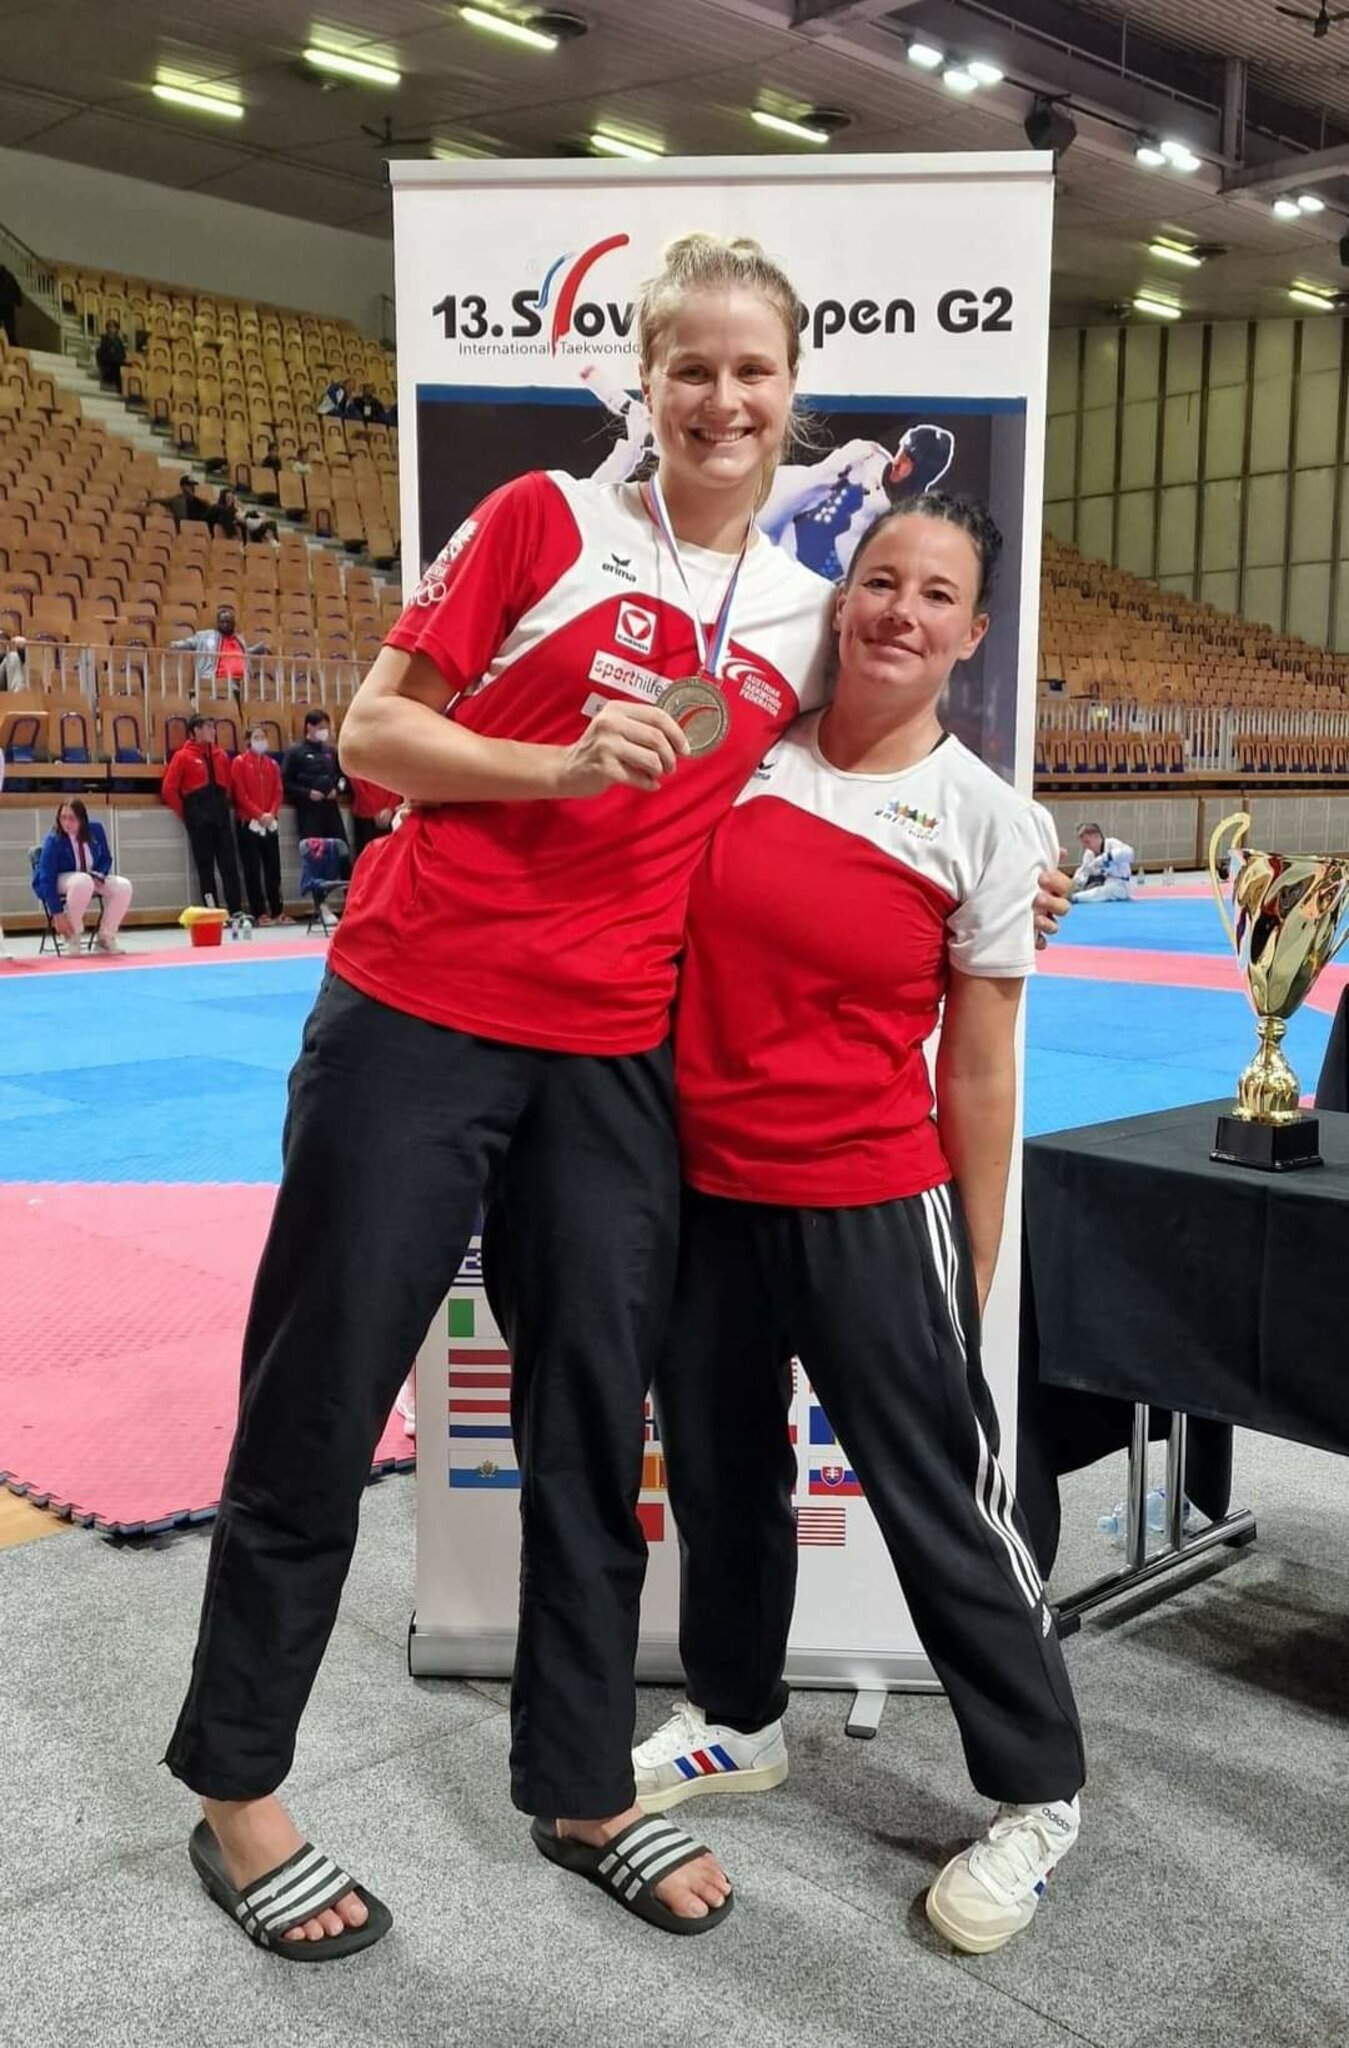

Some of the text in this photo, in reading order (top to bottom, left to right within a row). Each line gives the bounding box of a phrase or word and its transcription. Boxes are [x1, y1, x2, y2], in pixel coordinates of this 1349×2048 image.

[797, 298, 915, 348] pen
[937, 286, 1013, 333] G2
[459, 342, 550, 355] International
[602, 562, 636, 582] erima
[594, 660, 664, 697] sporthilfe
